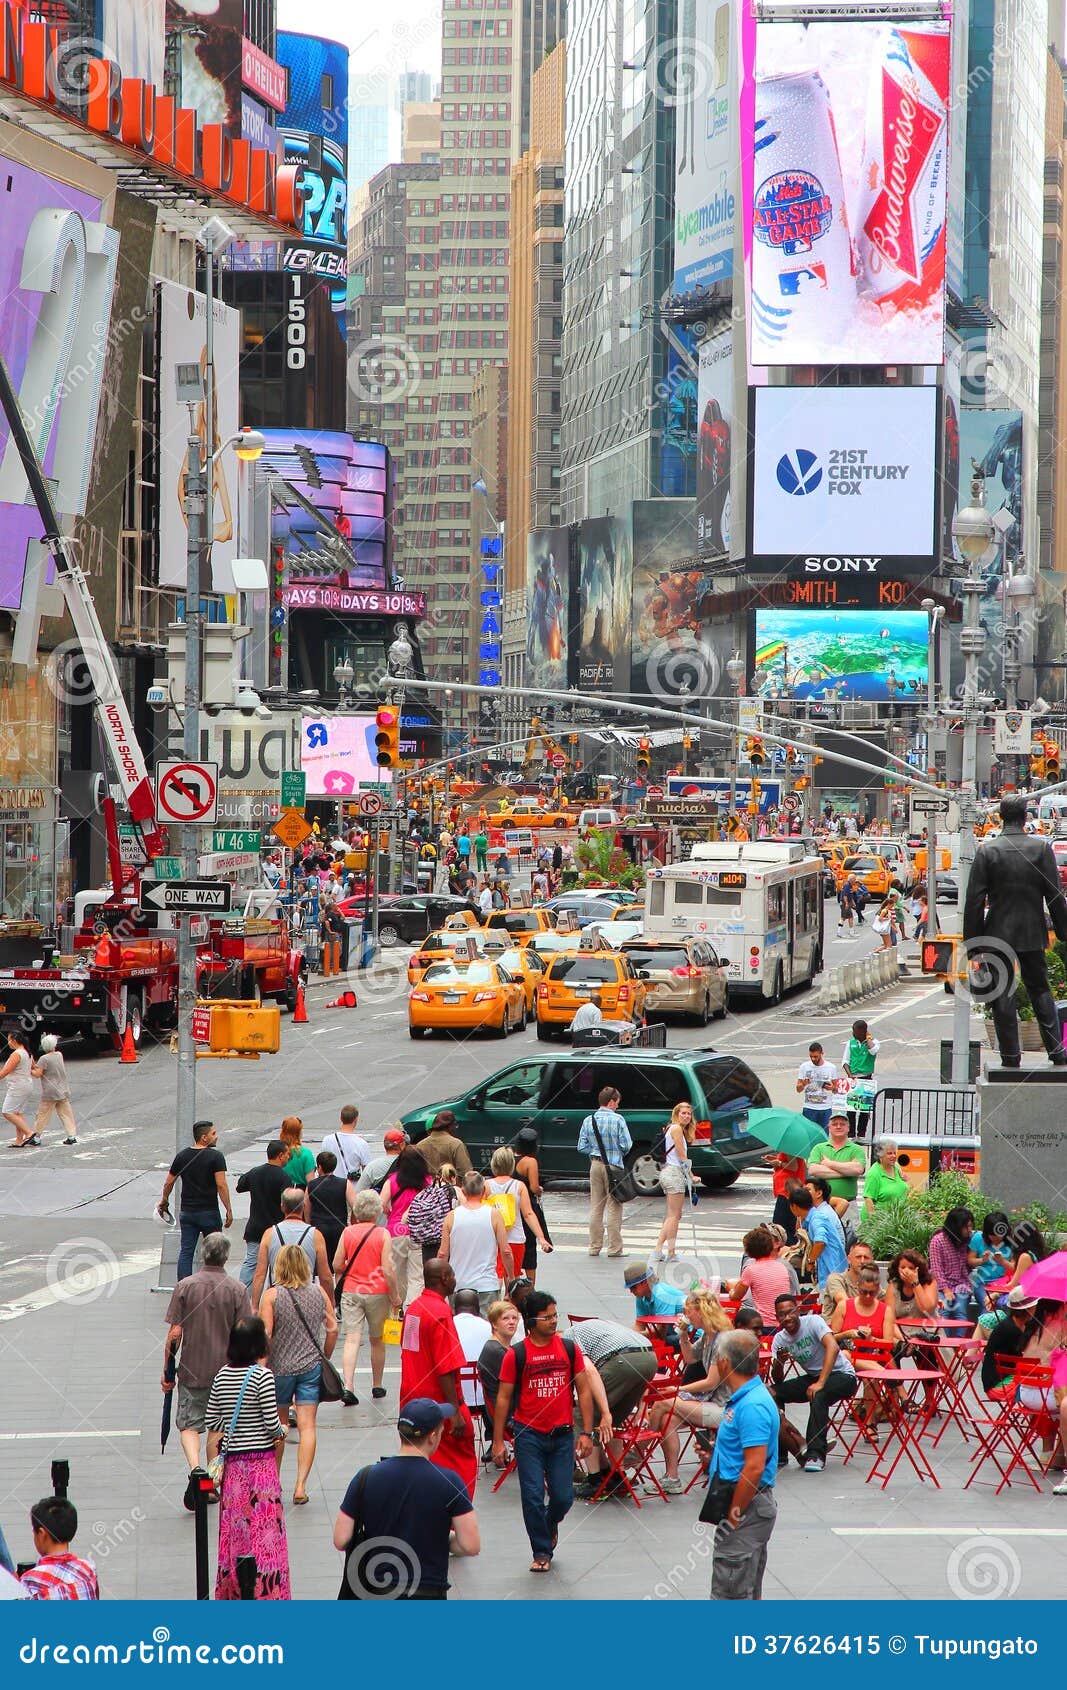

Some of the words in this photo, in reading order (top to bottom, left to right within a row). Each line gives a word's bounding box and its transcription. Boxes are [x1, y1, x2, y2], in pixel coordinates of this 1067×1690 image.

[245, 52, 284, 104] O'REILLY
[242, 103, 266, 143] STORY
[87, 58, 304, 230] BUILDING
[870, 74, 921, 275] Budweiser
[928, 192, 936, 208] OF
[677, 187, 735, 248] Lycamobile
[923, 210, 934, 236] KING
[769, 218, 820, 244] GAME
[287, 275, 305, 369] 1500
[828, 450, 867, 463] 21ST
[828, 465, 909, 480] CENTURY
[828, 481, 862, 495] FOX
[804, 558, 881, 572] SONY
[580, 668, 603, 678] PACIFIC
[105, 704, 127, 742] NORTH
[118, 745, 140, 782] SHORE
[217, 801, 270, 816] swatch
[657, 803, 706, 813] nuchas
[216, 833, 226, 850] W
[230, 833, 244, 850] 46
[248, 833, 258, 843] ST
[723, 873, 742, 884] M104
[164, 890, 188, 903] ONE
[195, 890, 222, 903] WAY
[528, 1375, 566, 1388] ATHLETIC
[537, 1388, 560, 1397] DEPT.
